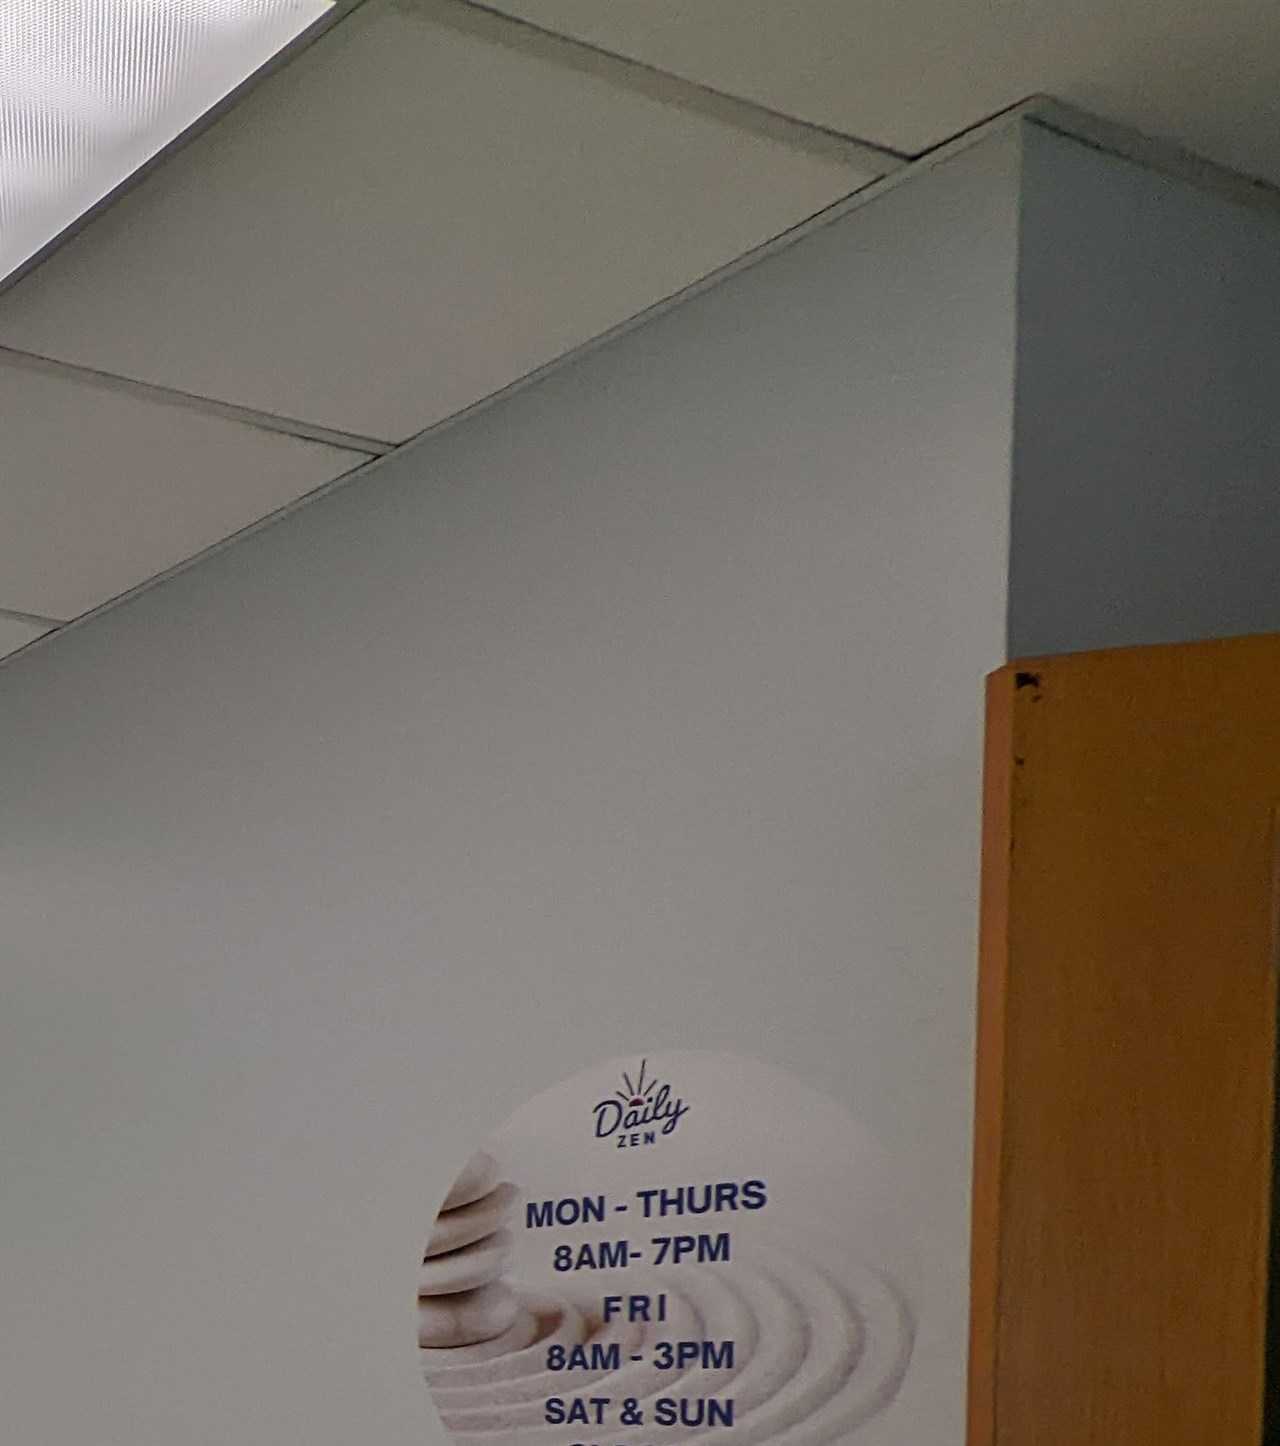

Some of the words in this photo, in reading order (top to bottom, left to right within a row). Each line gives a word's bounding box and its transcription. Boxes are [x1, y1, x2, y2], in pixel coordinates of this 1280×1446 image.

[592, 1084, 689, 1137] Daily
[617, 1131, 655, 1149] ZEN
[526, 1195, 605, 1229] MON
[636, 1180, 767, 1218] THURS
[651, 1232, 730, 1266] 7PM
[602, 1293, 666, 1324] FRI
[546, 1343, 620, 1372] 8AM
[653, 1340, 735, 1370] 3PM
[544, 1397, 611, 1425] SAT
[619, 1397, 644, 1426] &
[654, 1397, 734, 1428] SUN
